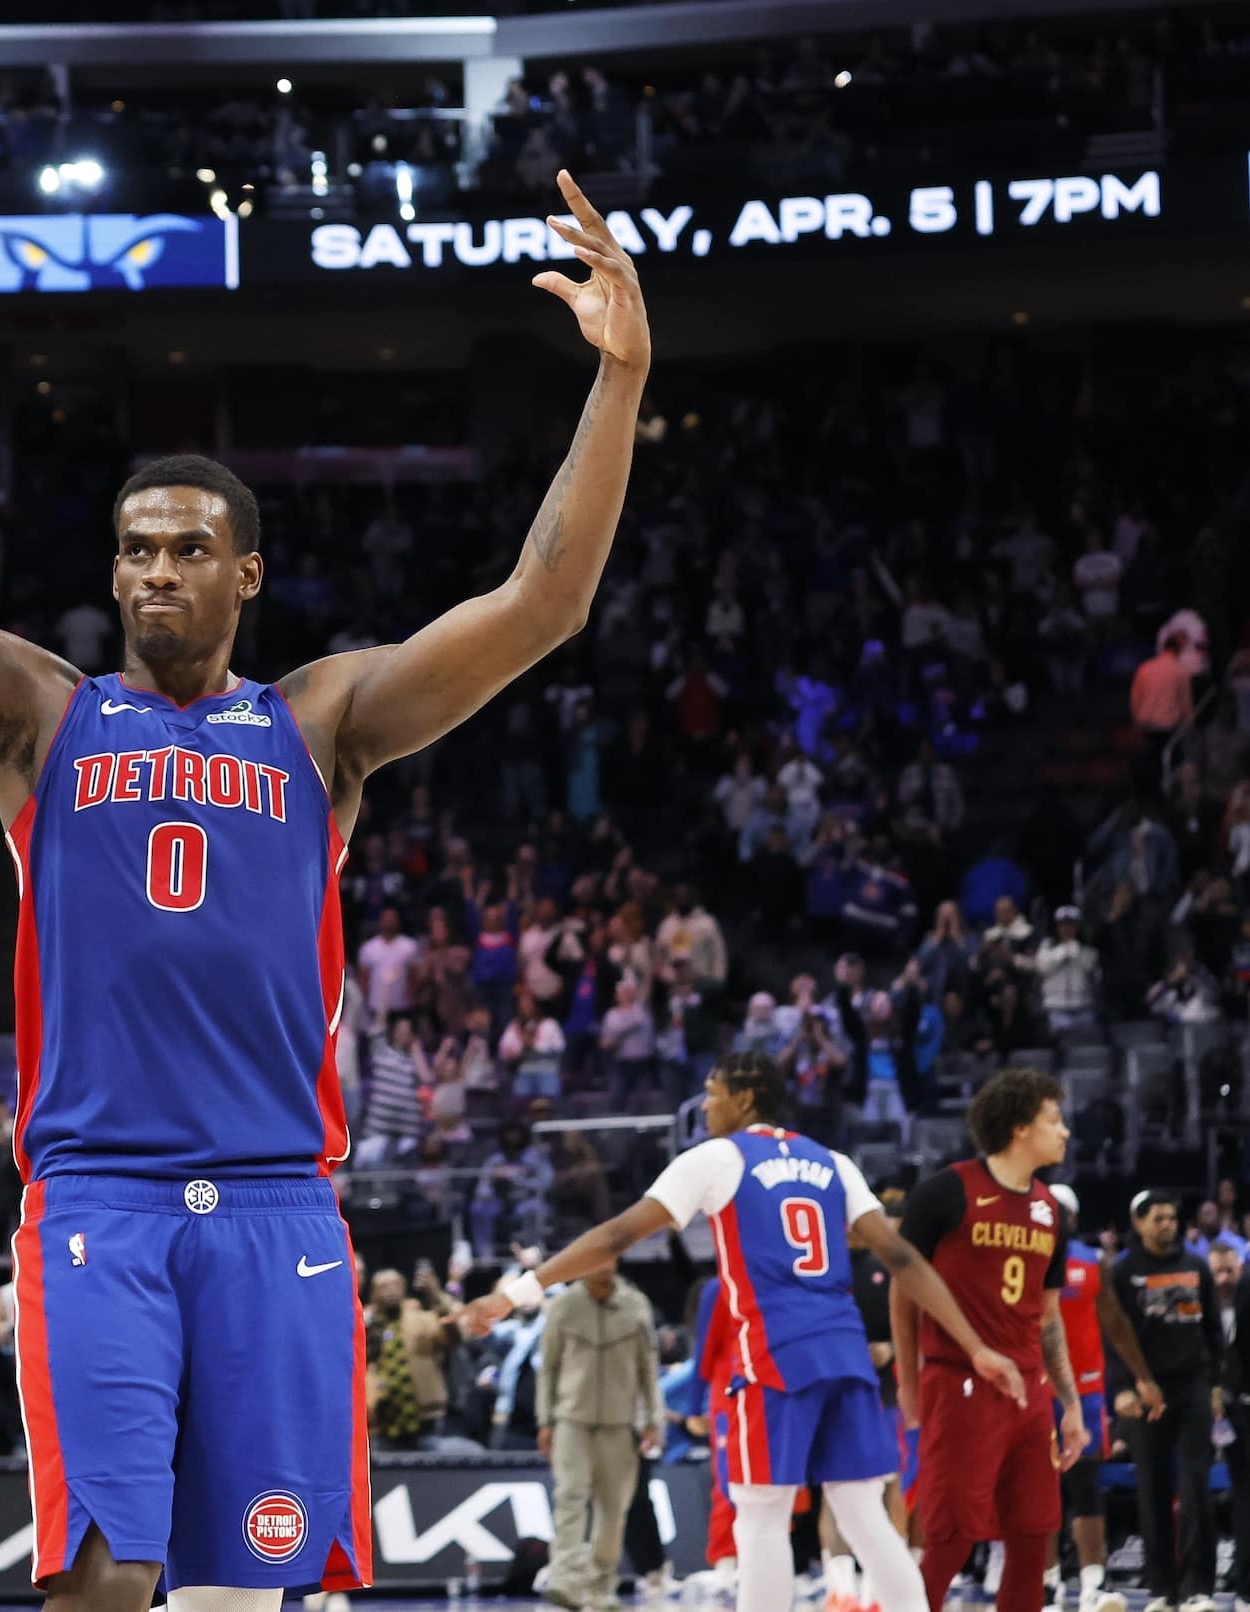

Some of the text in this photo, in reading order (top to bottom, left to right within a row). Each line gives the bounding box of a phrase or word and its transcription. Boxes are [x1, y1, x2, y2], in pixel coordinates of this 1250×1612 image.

[729, 192, 891, 247] APR.
[908, 186, 957, 234] 5
[1009, 171, 1161, 226] 7PM
[74, 745, 289, 823] DETROIT
[146, 821, 208, 912] 0
[780, 1196, 829, 1277] 9
[972, 1221, 1055, 1257] CLEVELAND
[1000, 1255, 1025, 1305] 9
[255, 1526, 297, 1538] PISTONS
[256, 1514, 297, 1526] DETROIT
